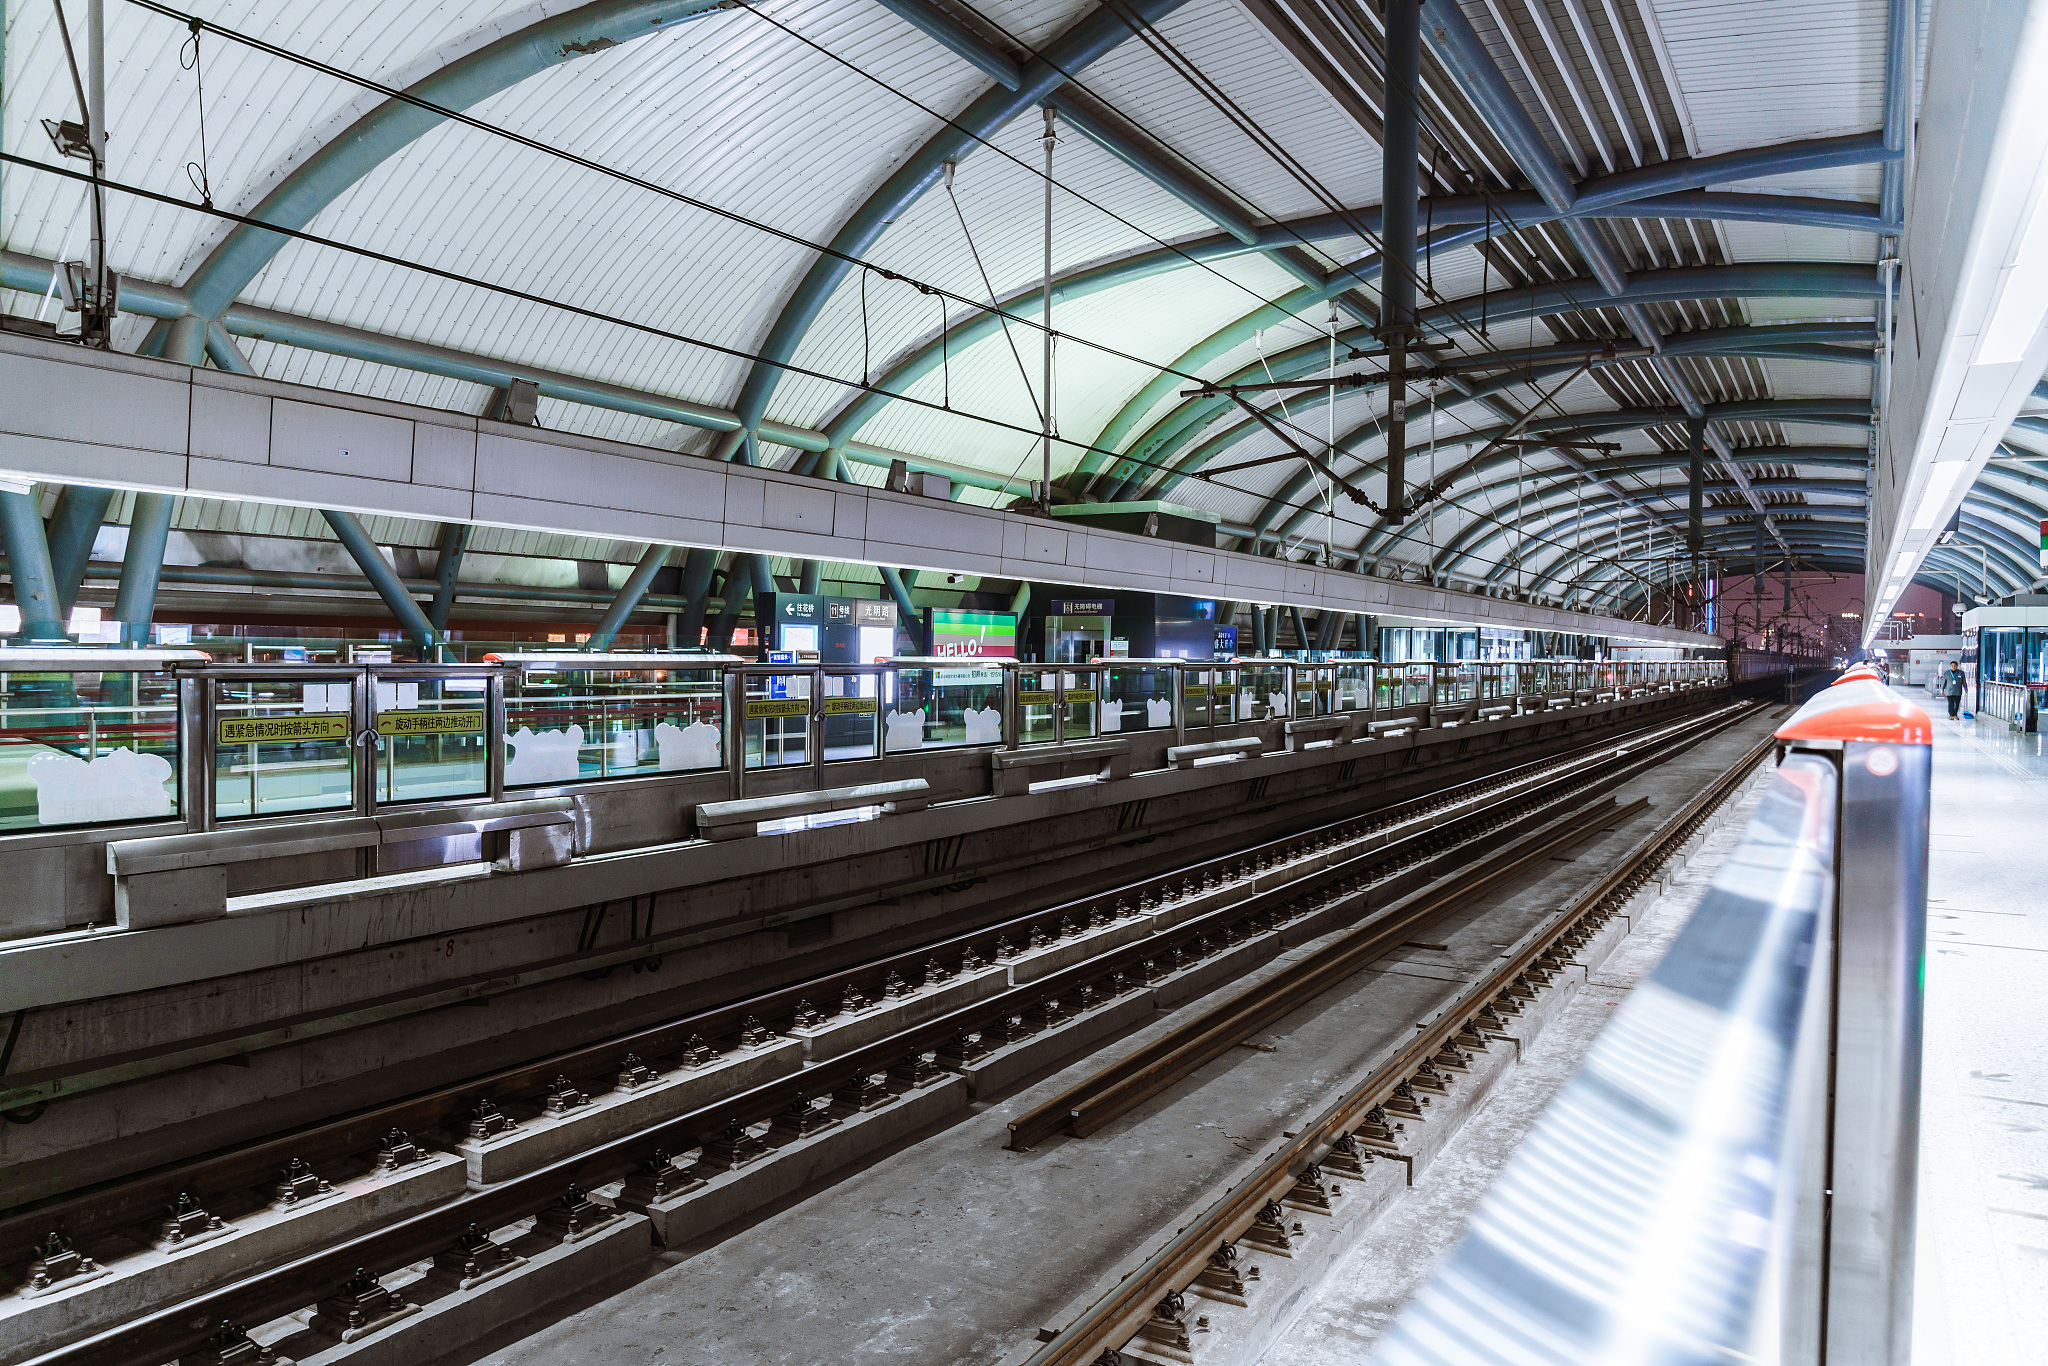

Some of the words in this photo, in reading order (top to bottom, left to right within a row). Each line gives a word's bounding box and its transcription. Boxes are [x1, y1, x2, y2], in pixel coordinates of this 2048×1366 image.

[796, 602, 815, 613] 往花桥
[838, 605, 850, 615] 号线
[864, 604, 889, 618] 光明路
[1074, 602, 1103, 611] 无障碍电梯
[937, 624, 986, 657] HELLO!
[224, 720, 330, 738] 遇紧急情况时按箭头方向
[394, 715, 481, 731] 旋动手柄往两边推动开门
[445, 938, 455, 958] 8
